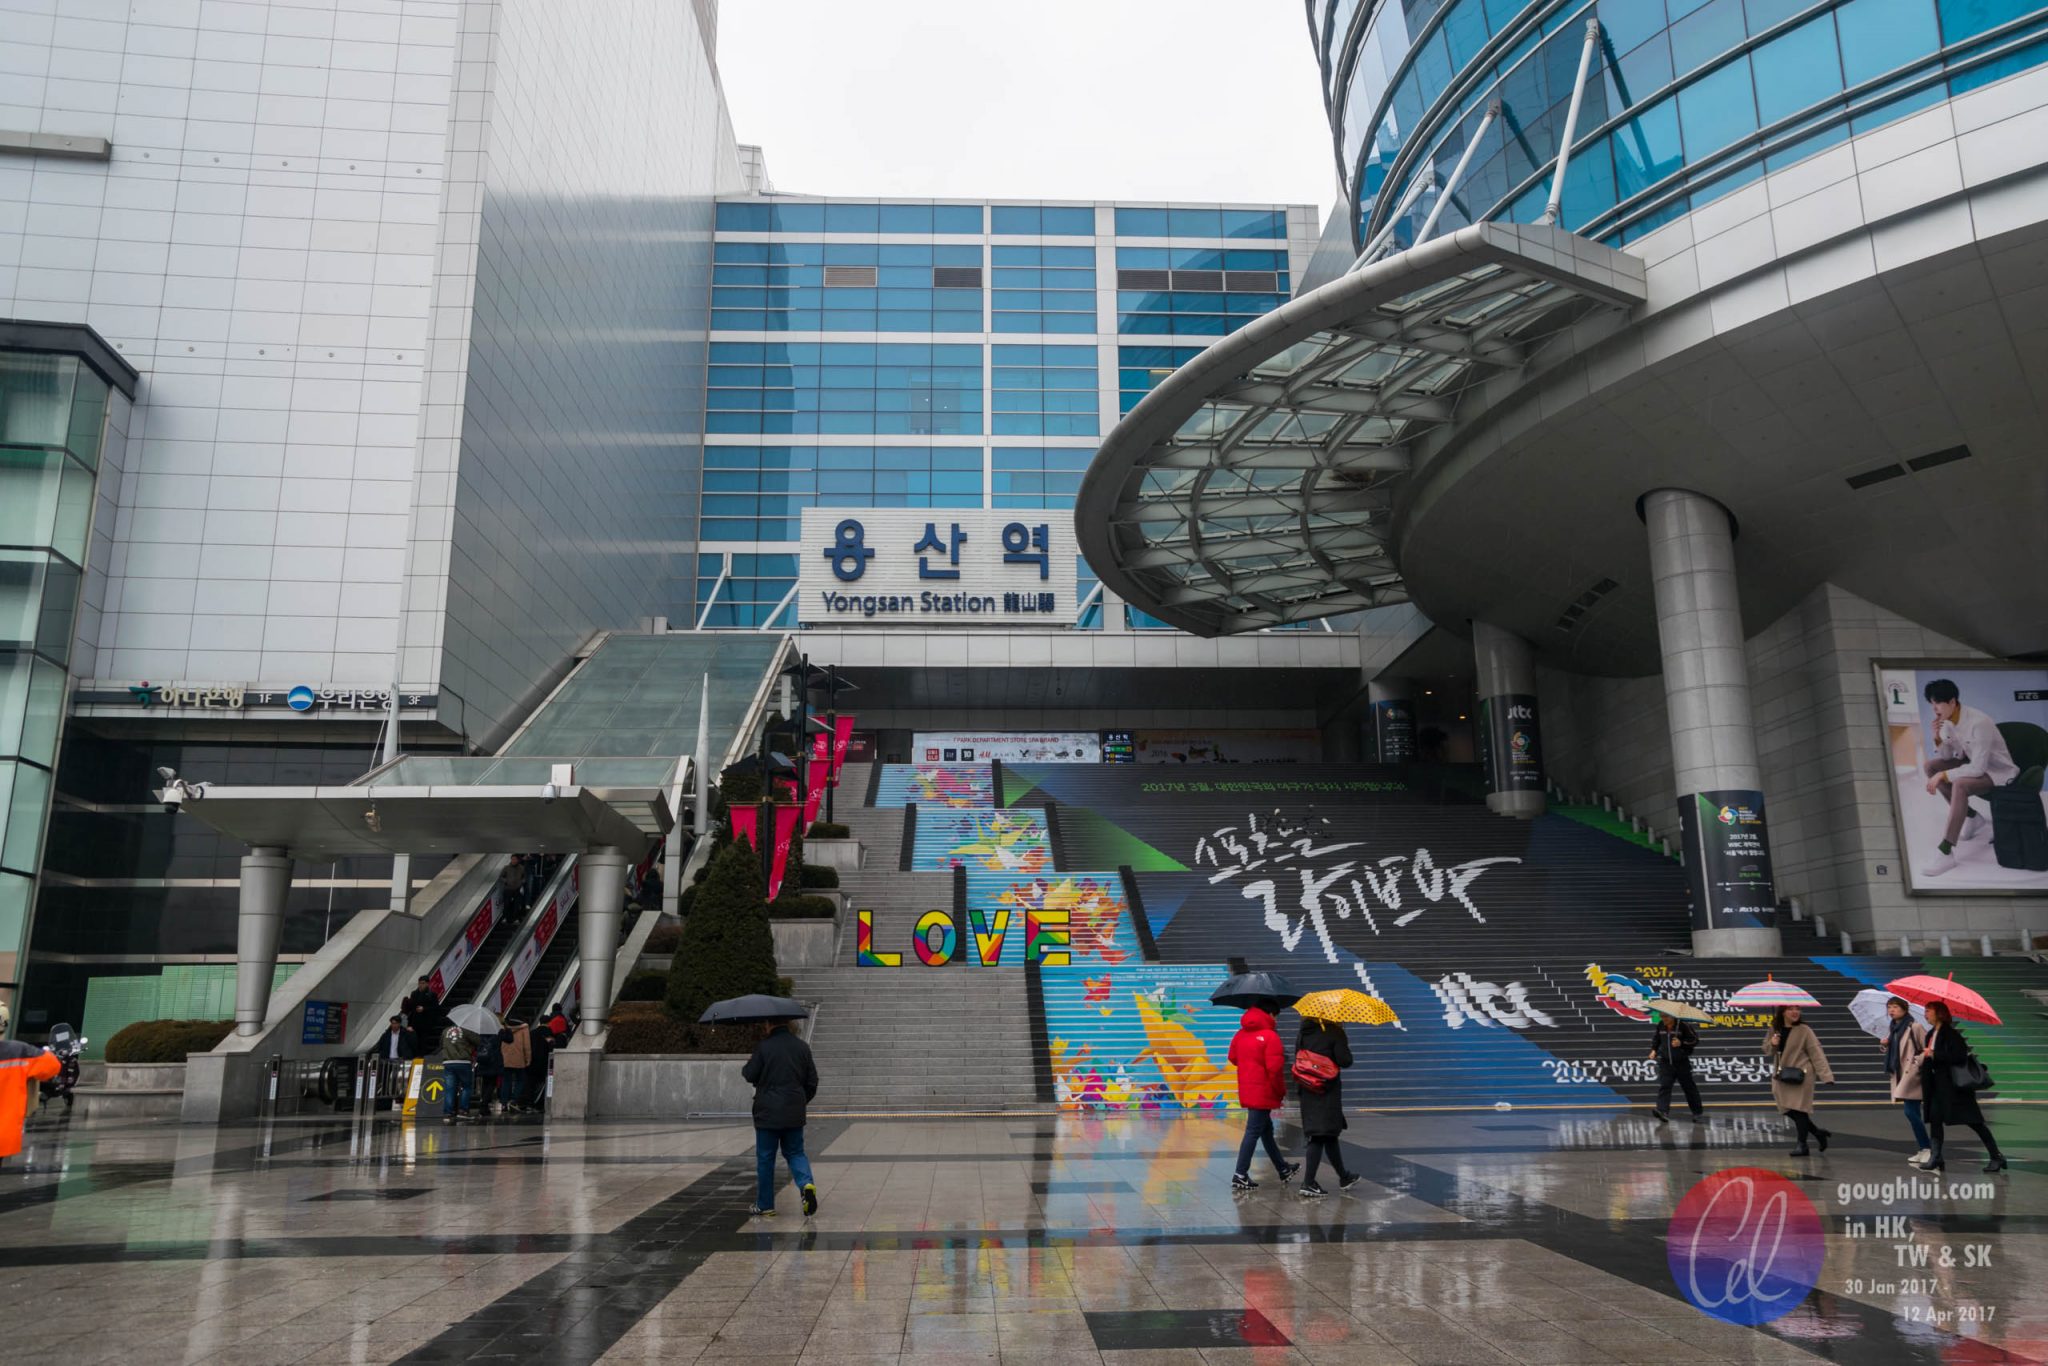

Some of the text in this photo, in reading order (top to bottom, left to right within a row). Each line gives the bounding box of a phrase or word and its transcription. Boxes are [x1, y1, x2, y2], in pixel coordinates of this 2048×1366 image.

[822, 591, 914, 617] Yongsan
[920, 591, 995, 613] Station
[160, 687, 272, 709] 하나은행 1F
[408, 695, 421, 706] 3F
[856, 909, 1072, 967] LOVE
[1650, 979, 1708, 989] WORLD
[1541, 1060, 1607, 1083] 2017
